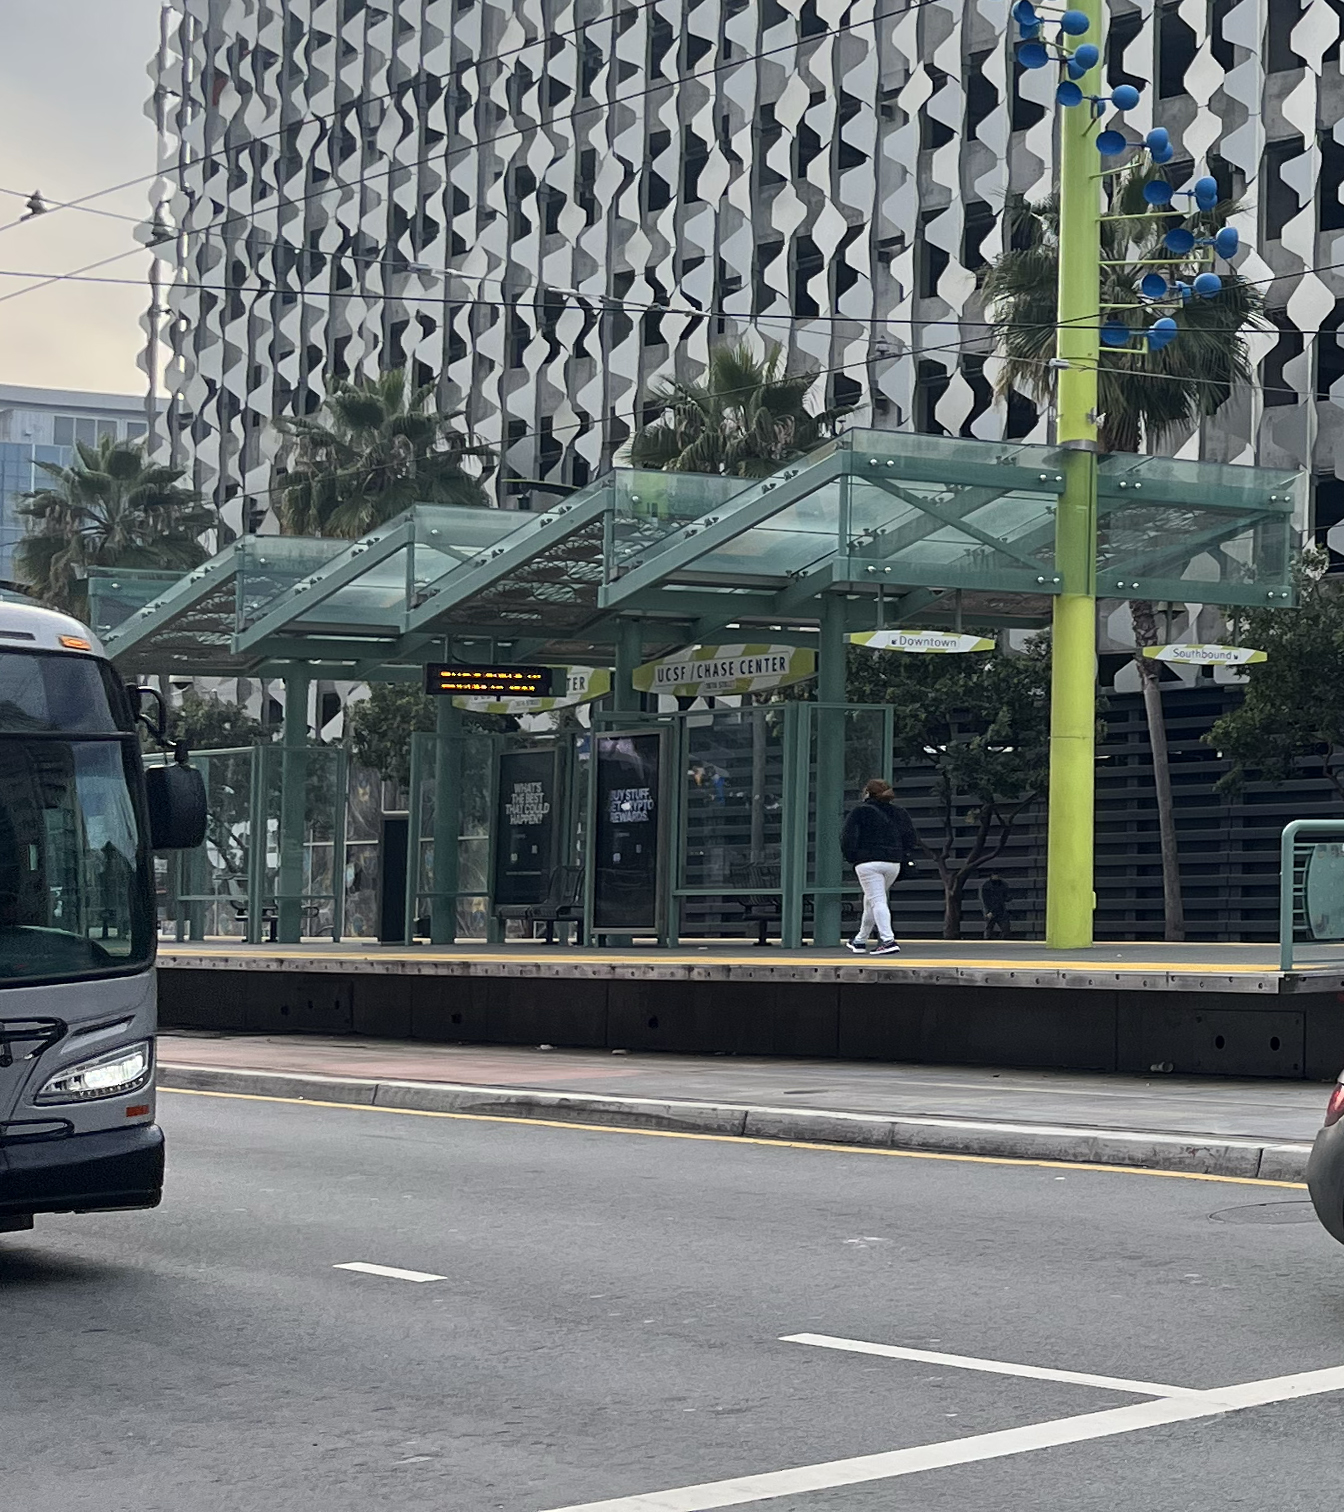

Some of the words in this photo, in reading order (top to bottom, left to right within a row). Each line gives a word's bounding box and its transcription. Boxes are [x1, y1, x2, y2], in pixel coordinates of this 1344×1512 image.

[899, 635, 957, 648] Downtown
[1173, 648, 1232, 660] Southbound
[739, 656, 786, 675] CENTER
[511, 793, 525, 803] THE
[525, 792, 544, 803] BEST
[505, 804, 523, 814] THAT
[524, 802, 550, 814] COULD
